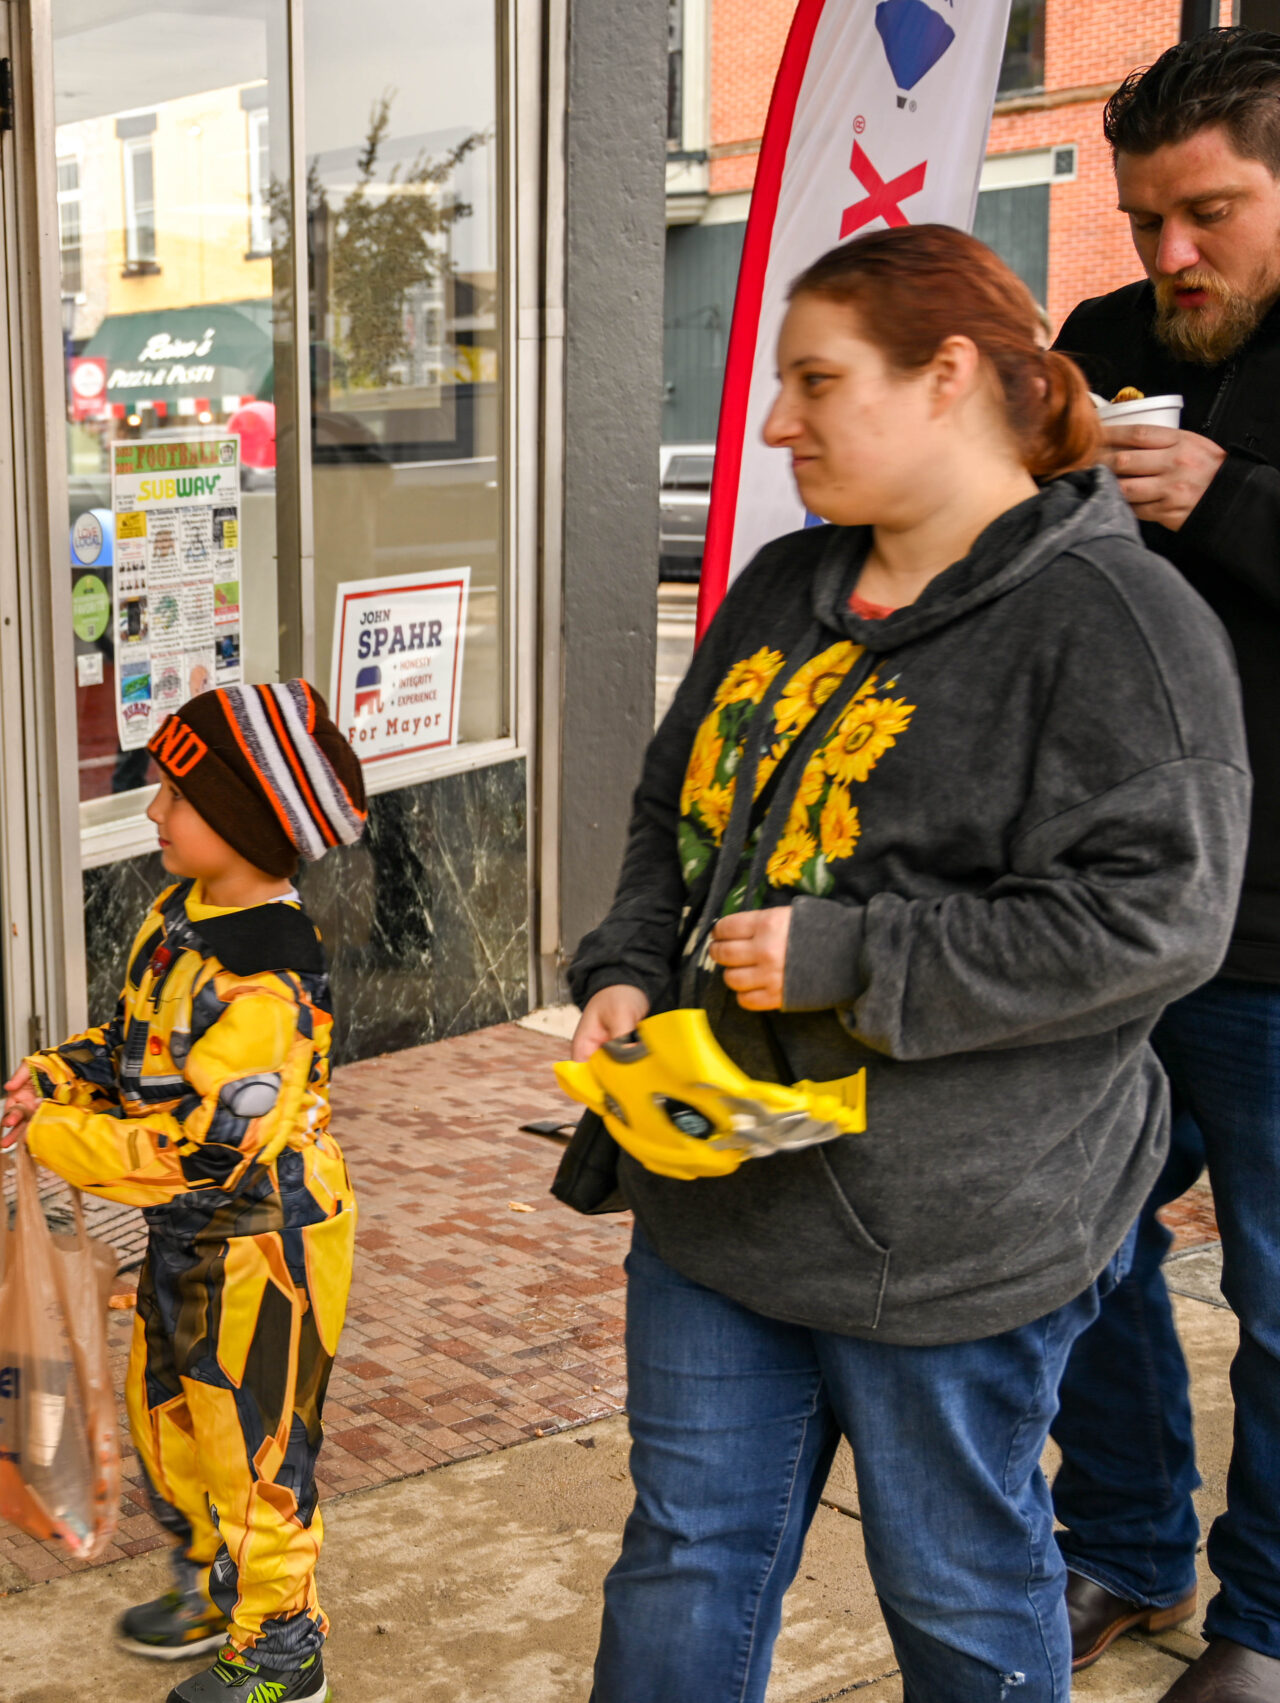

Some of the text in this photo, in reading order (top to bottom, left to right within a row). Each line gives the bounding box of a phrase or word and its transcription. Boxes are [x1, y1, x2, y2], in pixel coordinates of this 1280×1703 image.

[136, 441, 218, 469] FOOTBALL
[136, 474, 221, 502] SUBWAY
[78, 526, 98, 539] LOVE
[75, 536, 100, 548] LOCAL
[360, 609, 391, 625] JOHN
[358, 620, 442, 660] SPAHR
[400, 657, 431, 670] HONESTY
[399, 674, 432, 689] INTEGRITY
[397, 690, 438, 707] EXPERIENCE
[348, 712, 442, 744] For Mayor
